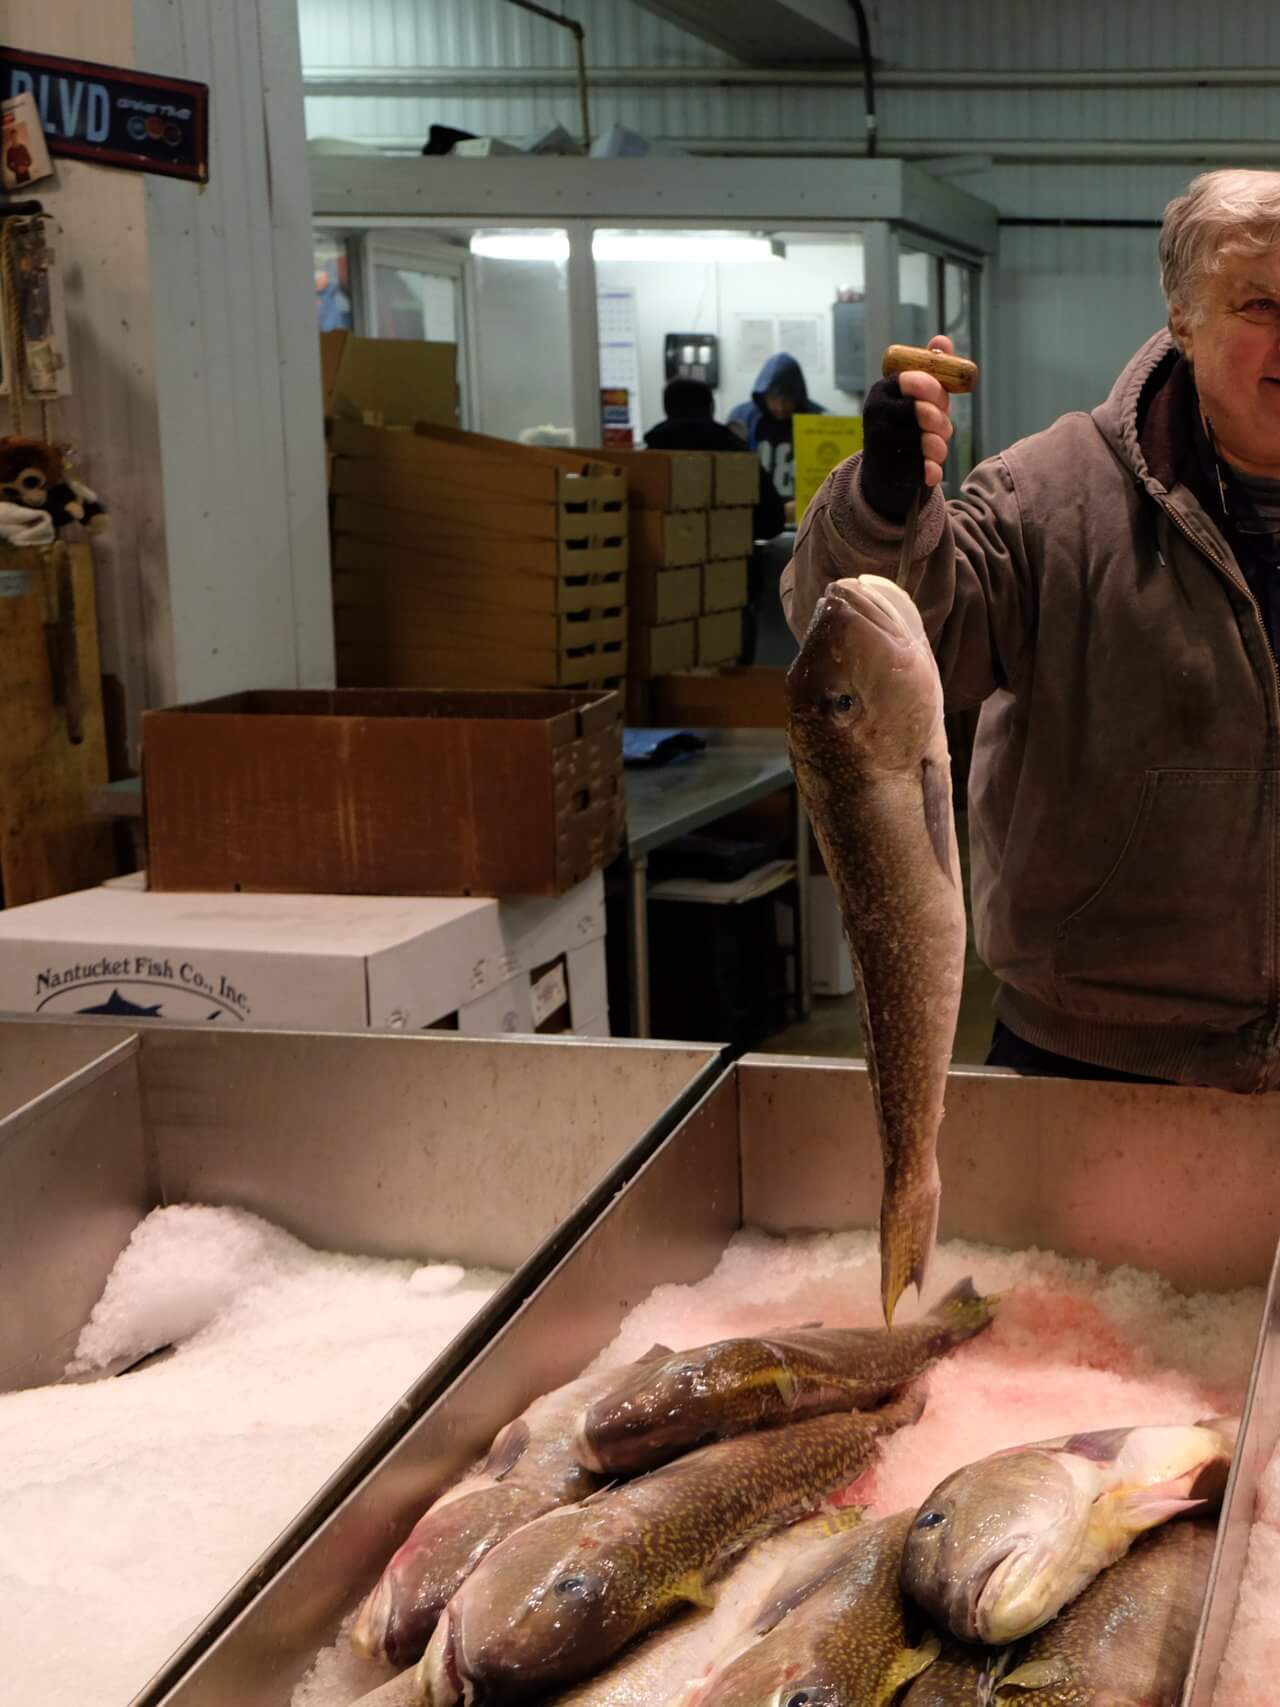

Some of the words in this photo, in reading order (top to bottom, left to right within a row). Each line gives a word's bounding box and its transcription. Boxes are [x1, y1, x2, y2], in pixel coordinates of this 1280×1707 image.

[35, 957, 130, 995] Nantucket
[135, 957, 174, 979] Fish
[180, 963, 214, 994] Co.,
